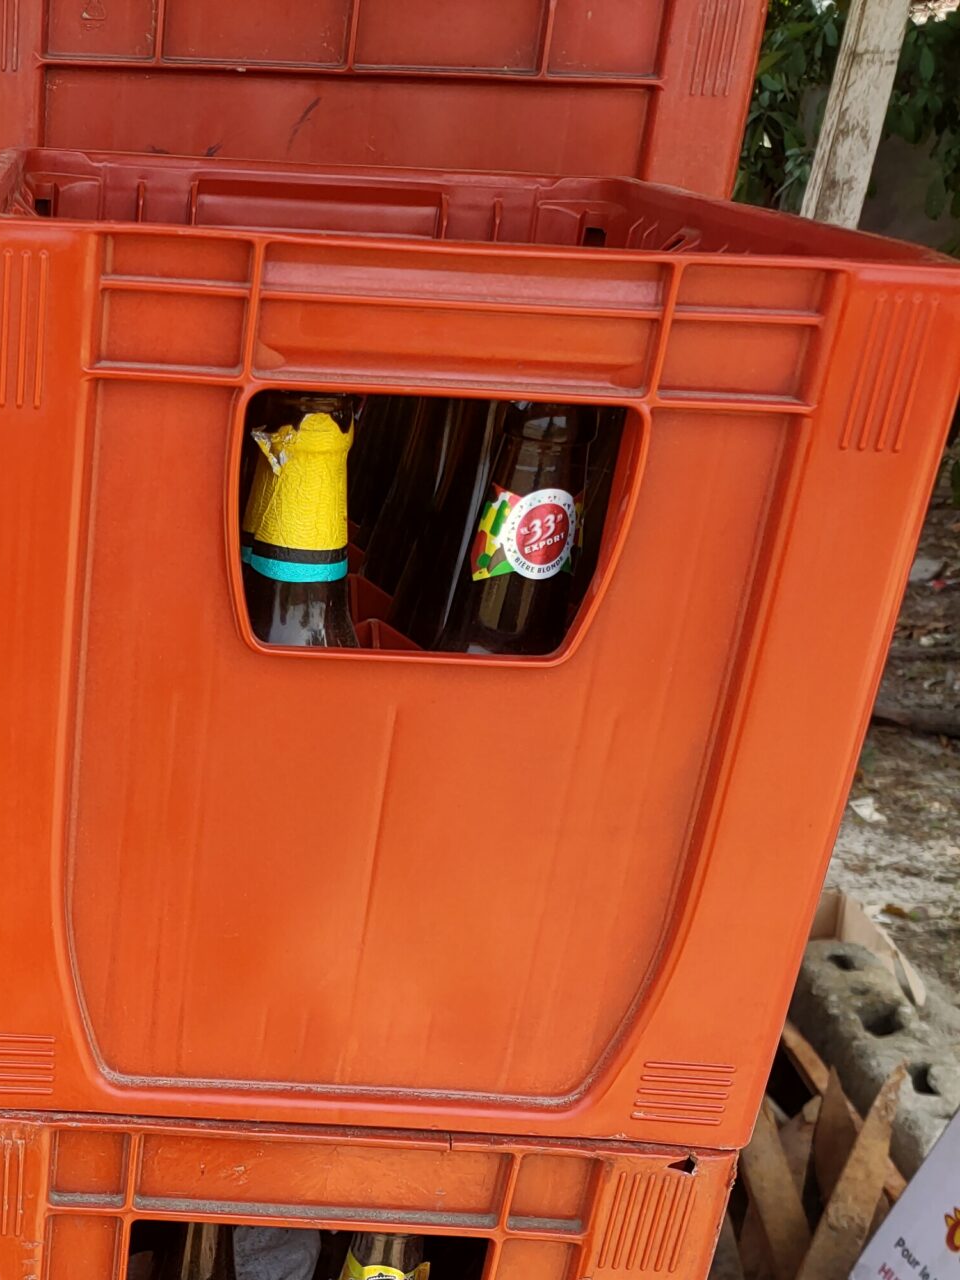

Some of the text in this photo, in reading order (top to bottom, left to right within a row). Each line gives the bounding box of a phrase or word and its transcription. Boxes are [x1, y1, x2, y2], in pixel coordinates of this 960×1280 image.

[524, 532, 565, 554] EXPORT
[537, 556, 564, 573] BLONDE
[894, 1236, 921, 1270] Pour
